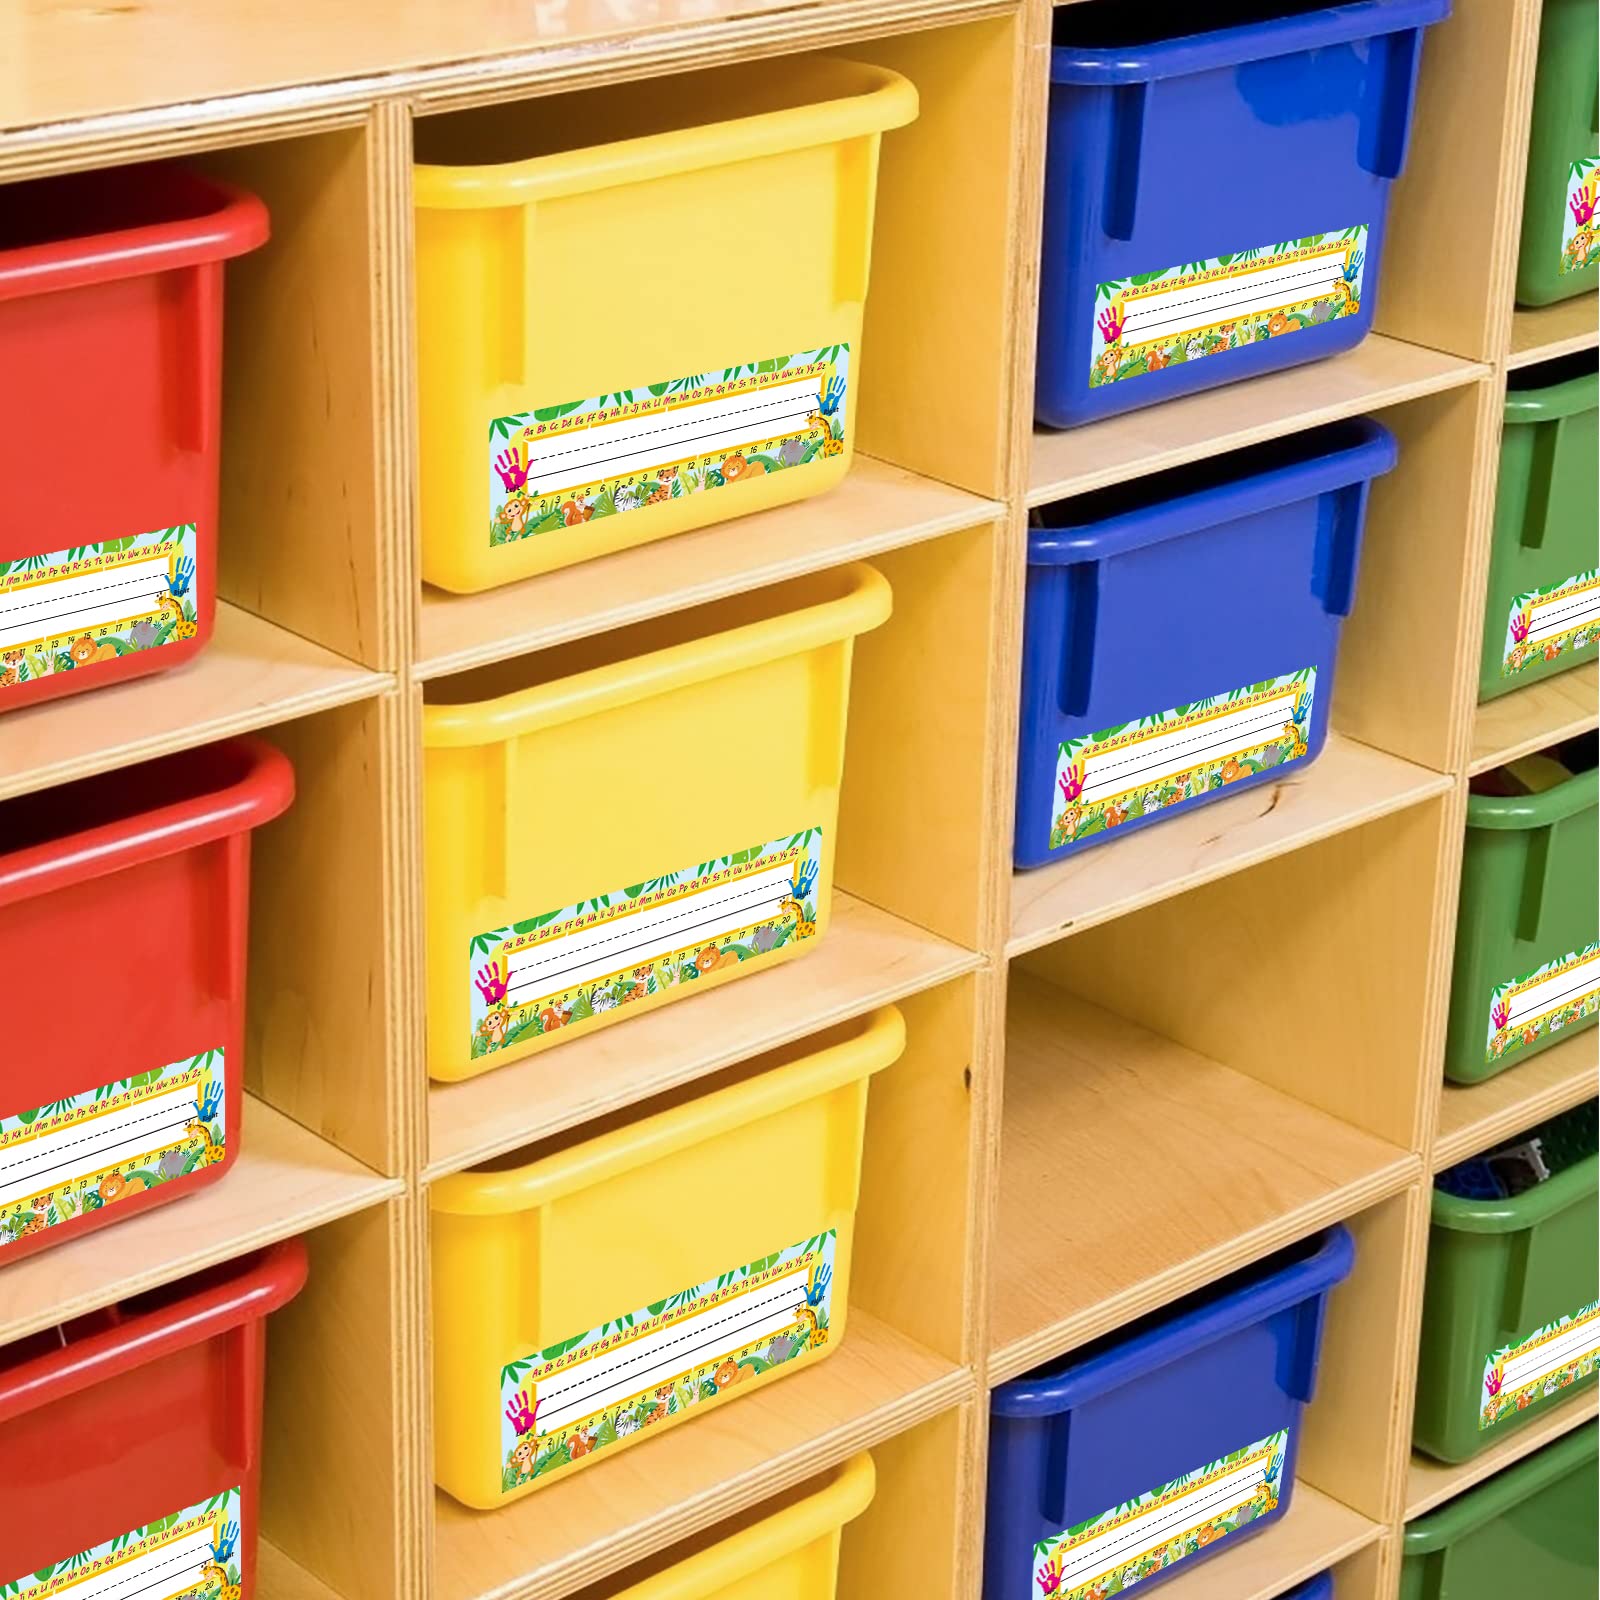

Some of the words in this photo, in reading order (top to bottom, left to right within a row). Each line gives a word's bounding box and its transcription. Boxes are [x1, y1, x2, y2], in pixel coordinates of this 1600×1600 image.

[523, 427, 534, 437] Aa
[536, 424, 547, 434] Bb
[549, 422, 559, 431] Cc
[561, 418, 572, 429] Dd
[575, 416, 584, 426] Ee
[587, 413, 597, 422] Ff
[610, 407, 621, 417] Hh
[630, 403, 639, 414] Jj
[641, 401, 651, 410] Kk
[653, 398, 661, 408] Ll
[662, 396, 677, 406] Mm
[679, 392, 690, 402] Nn
[692, 390, 702, 399] Oo
[704, 387, 714, 396] Pp
[716, 384, 725, 394] Qq
[727, 382, 736, 391] Rr
[759, 375, 769, 384] Uu
[771, 373, 780, 381] Vv
[781, 369, 793, 379] Ww
[795, 366, 804, 375] Xx
[806, 364, 815, 374] Yy
[816, 361, 826, 371] Zz
[539, 498, 547, 509] 2
[554, 494, 562, 505] 3
[570, 491, 577, 501] 4
[584, 487, 592, 497] 5
[599, 483, 606, 493] 6
[614, 480, 620, 489] 7
[628, 476, 635, 486] 8
[642, 472, 649, 482] 9
[656, 468, 665, 479] 10
[672, 465, 680, 474] 11
[687, 460, 696, 471] 12
[703, 456, 712, 467] 13
[718, 452, 727, 463] 14
[734, 449, 743, 458] 15
[750, 445, 758, 455] 16
[765, 441, 773, 451] 17
[779, 437, 788, 447] 18
[794, 433, 802, 443] 19
[808, 429, 819, 439] 20
[6, 576, 20, 586] Mm
[36, 570, 46, 579] Oo
[48, 567, 58, 577] Pp
[60, 565, 70, 574] Qq
[72, 562, 81, 571] Rr
[117, 553, 126, 561] Vv
[153, 544, 161, 554] Yy
[163, 542, 172, 551] Zz
[2, 651, 11, 662] 10
[34, 643, 43, 653] 12
[51, 639, 60, 649] 13
[67, 635, 76, 645] 14
[83, 630, 92, 641] 15
[99, 626, 108, 637] 16
[115, 622, 123, 633] 17
[130, 619, 138, 629] 18
[145, 615, 153, 625] 19
[160, 611, 170, 621] 20
[547, 1436, 554, 1447] 2
[560, 1430, 568, 1441] 3
[575, 1423, 581, 1434] 4
[588, 1417, 595, 1428] 5
[601, 1411, 608, 1422] 6
[628, 1399, 634, 1410] 8
[641, 1393, 647, 1404] 9
[683, 1373, 691, 1385] 12
[697, 1367, 706, 1378] 13
[726, 1354, 735, 1365] 15
[741, 1347, 749, 1358] 16
[755, 1341, 763, 1352] 17
[796, 1322, 805, 1333] 20
